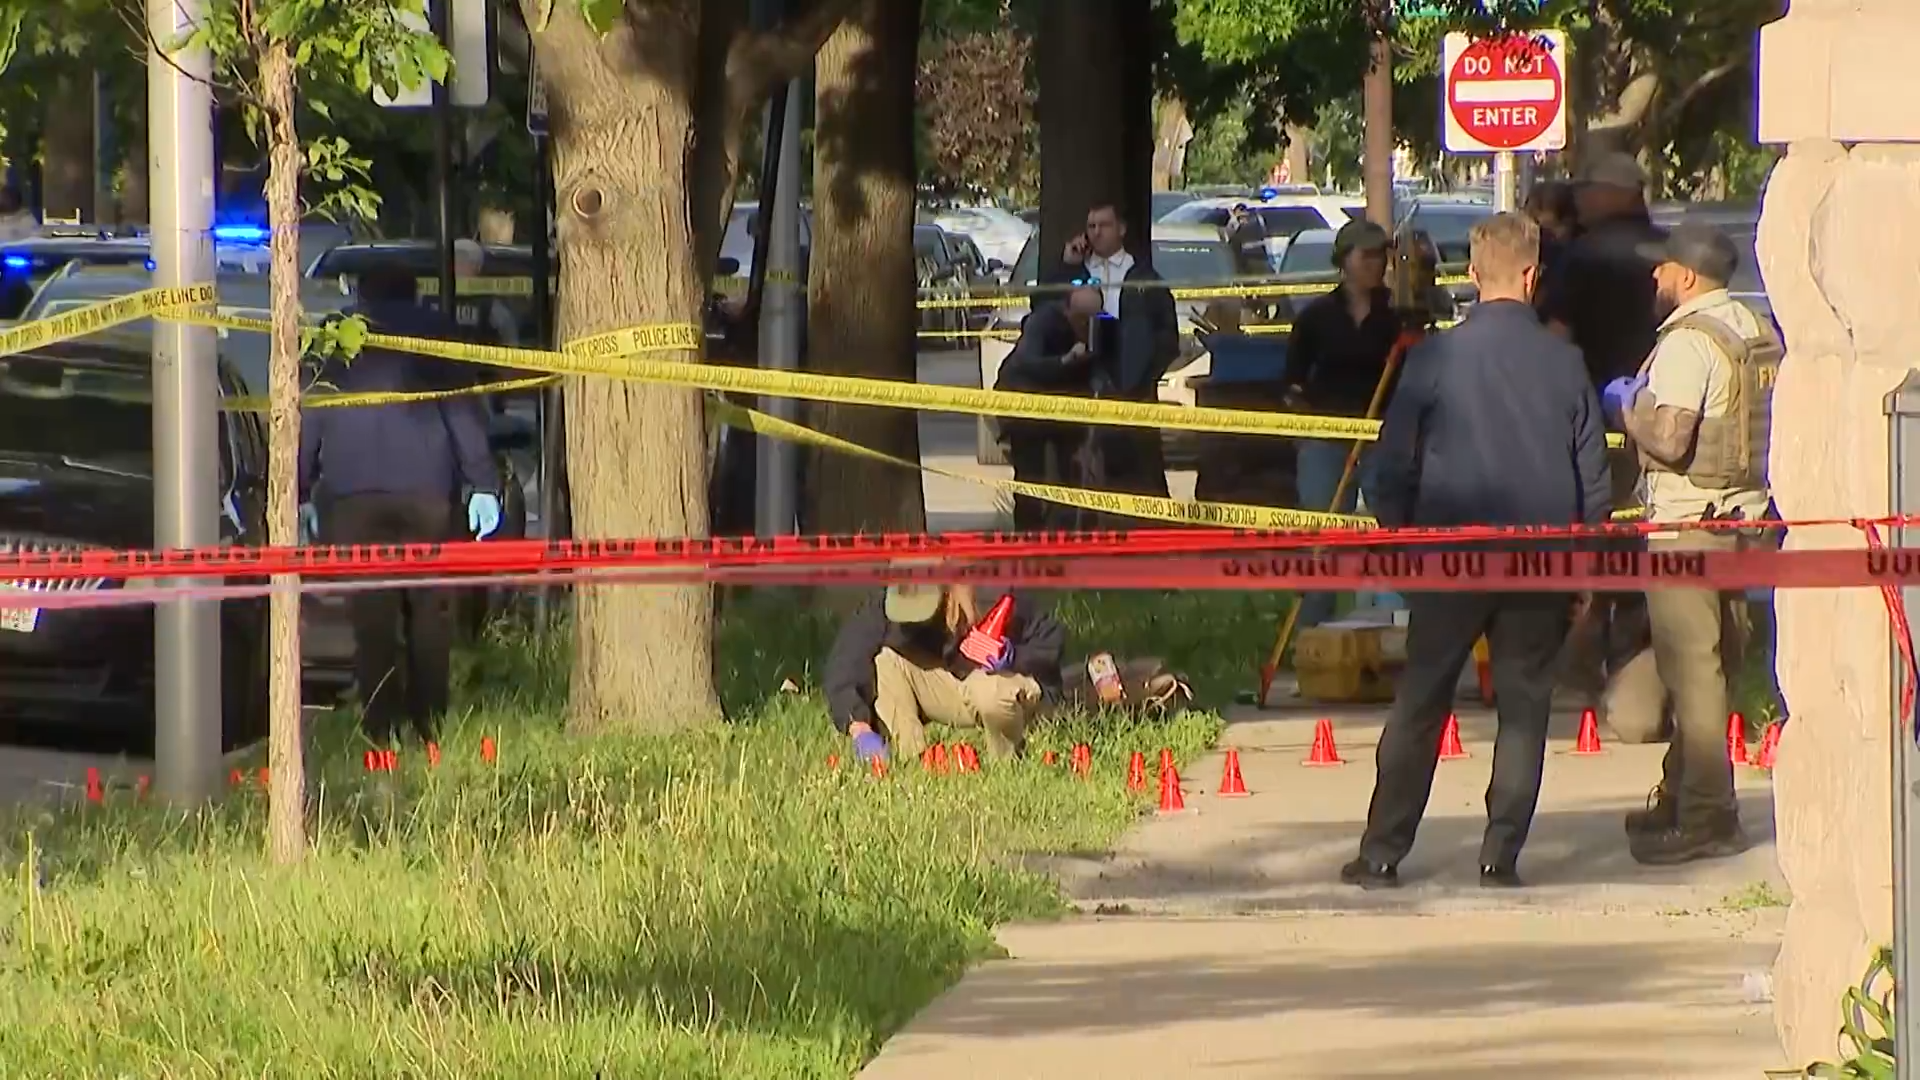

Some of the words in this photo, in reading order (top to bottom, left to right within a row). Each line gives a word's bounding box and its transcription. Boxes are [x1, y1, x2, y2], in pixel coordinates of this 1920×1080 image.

[1464, 56, 1491, 74] DO
[1504, 56, 1545, 74] NOT
[1473, 107, 1537, 125] ENTER
[171, 288, 197, 305] LINE
[200, 286, 213, 300] DO
[587, 335, 619, 357] CROSS
[632, 327, 668, 350] POLICE
[670, 326, 692, 345] LINE
[1088, 494, 1121, 510] POLICE
[1132, 497, 1164, 516] CROSS
[1168, 502, 1186, 519] NOT
[1188, 502, 1201, 519] DO
[1203, 505, 1223, 523] LINE
[1226, 509, 1257, 525] POLICE
[1269, 511, 1301, 528] CROSS
